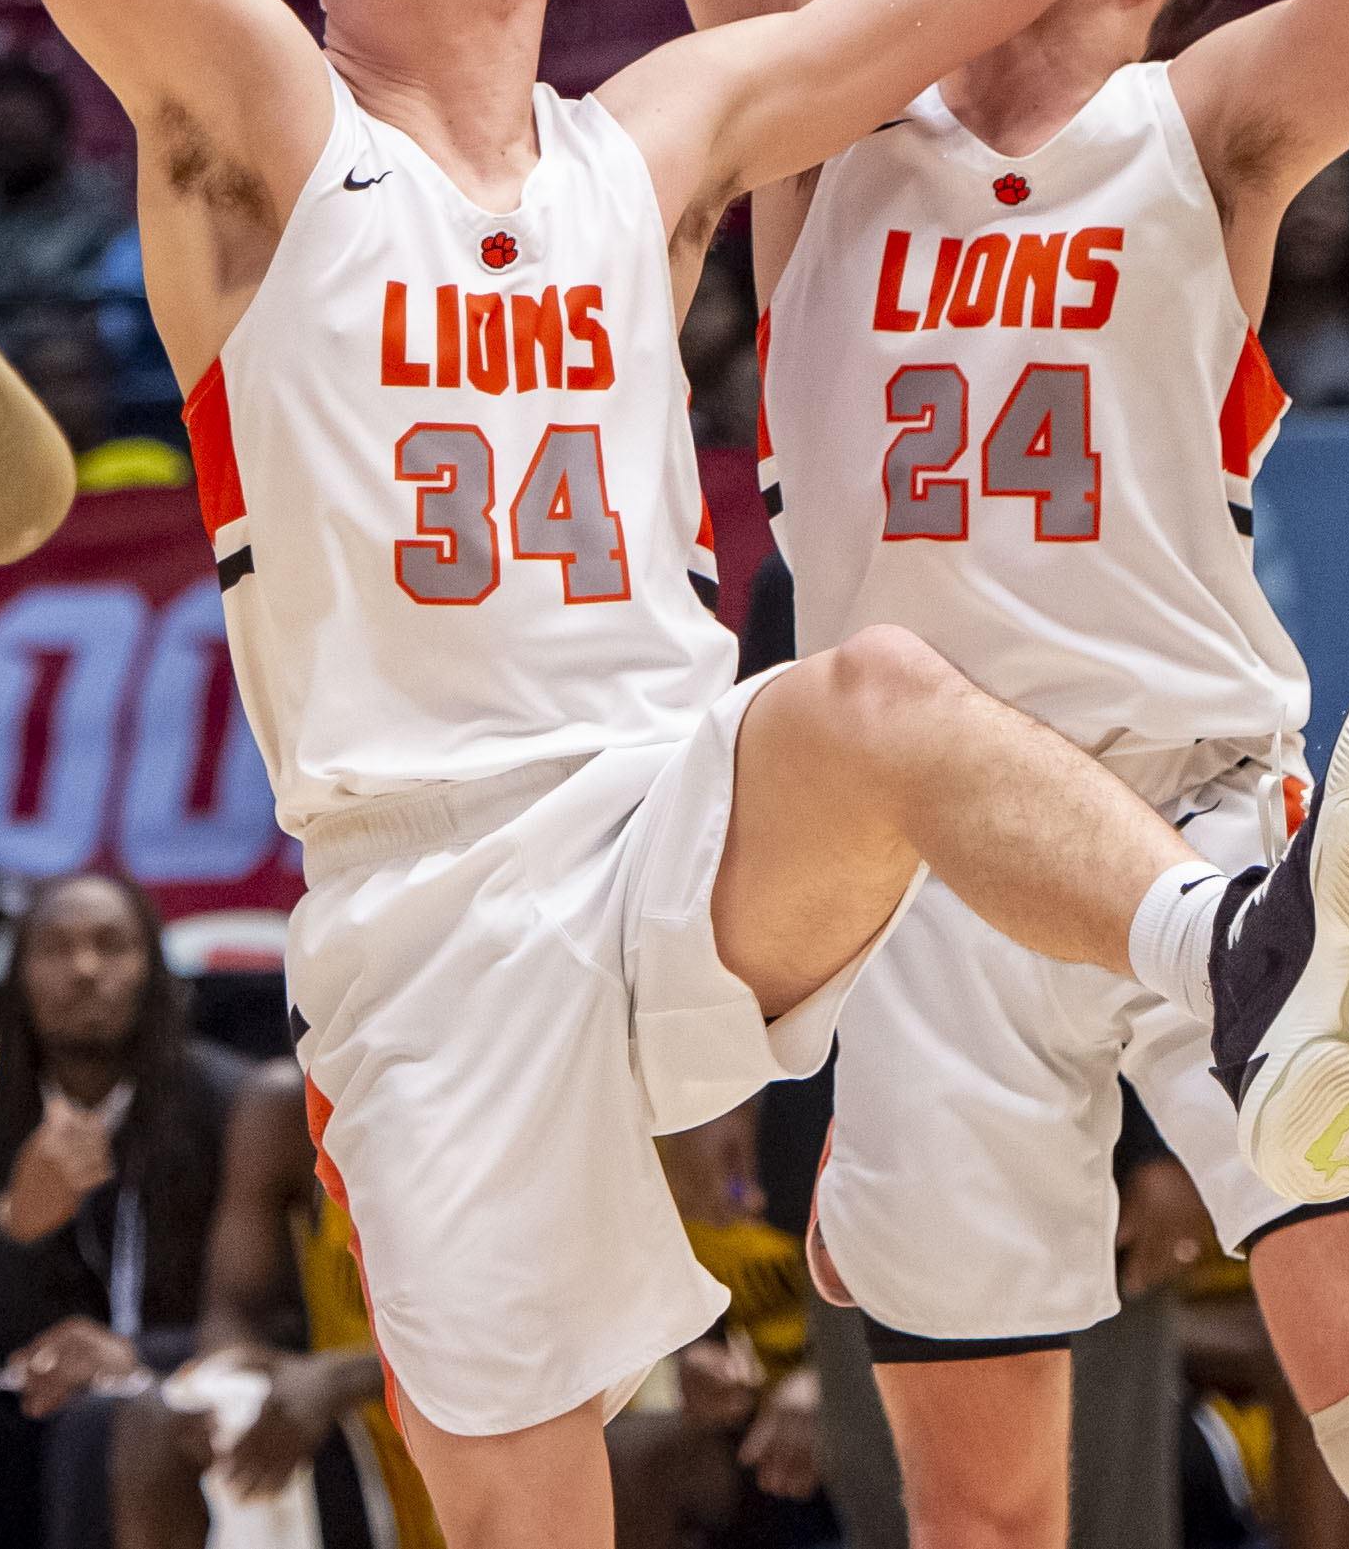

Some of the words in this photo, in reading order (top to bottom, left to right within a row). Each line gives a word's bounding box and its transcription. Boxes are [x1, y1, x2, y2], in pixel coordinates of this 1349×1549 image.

[380, 280, 616, 396] LIONS
[872, 226, 1125, 333] LIONS
[394, 421, 632, 606] 34
[881, 361, 1101, 543] 24
